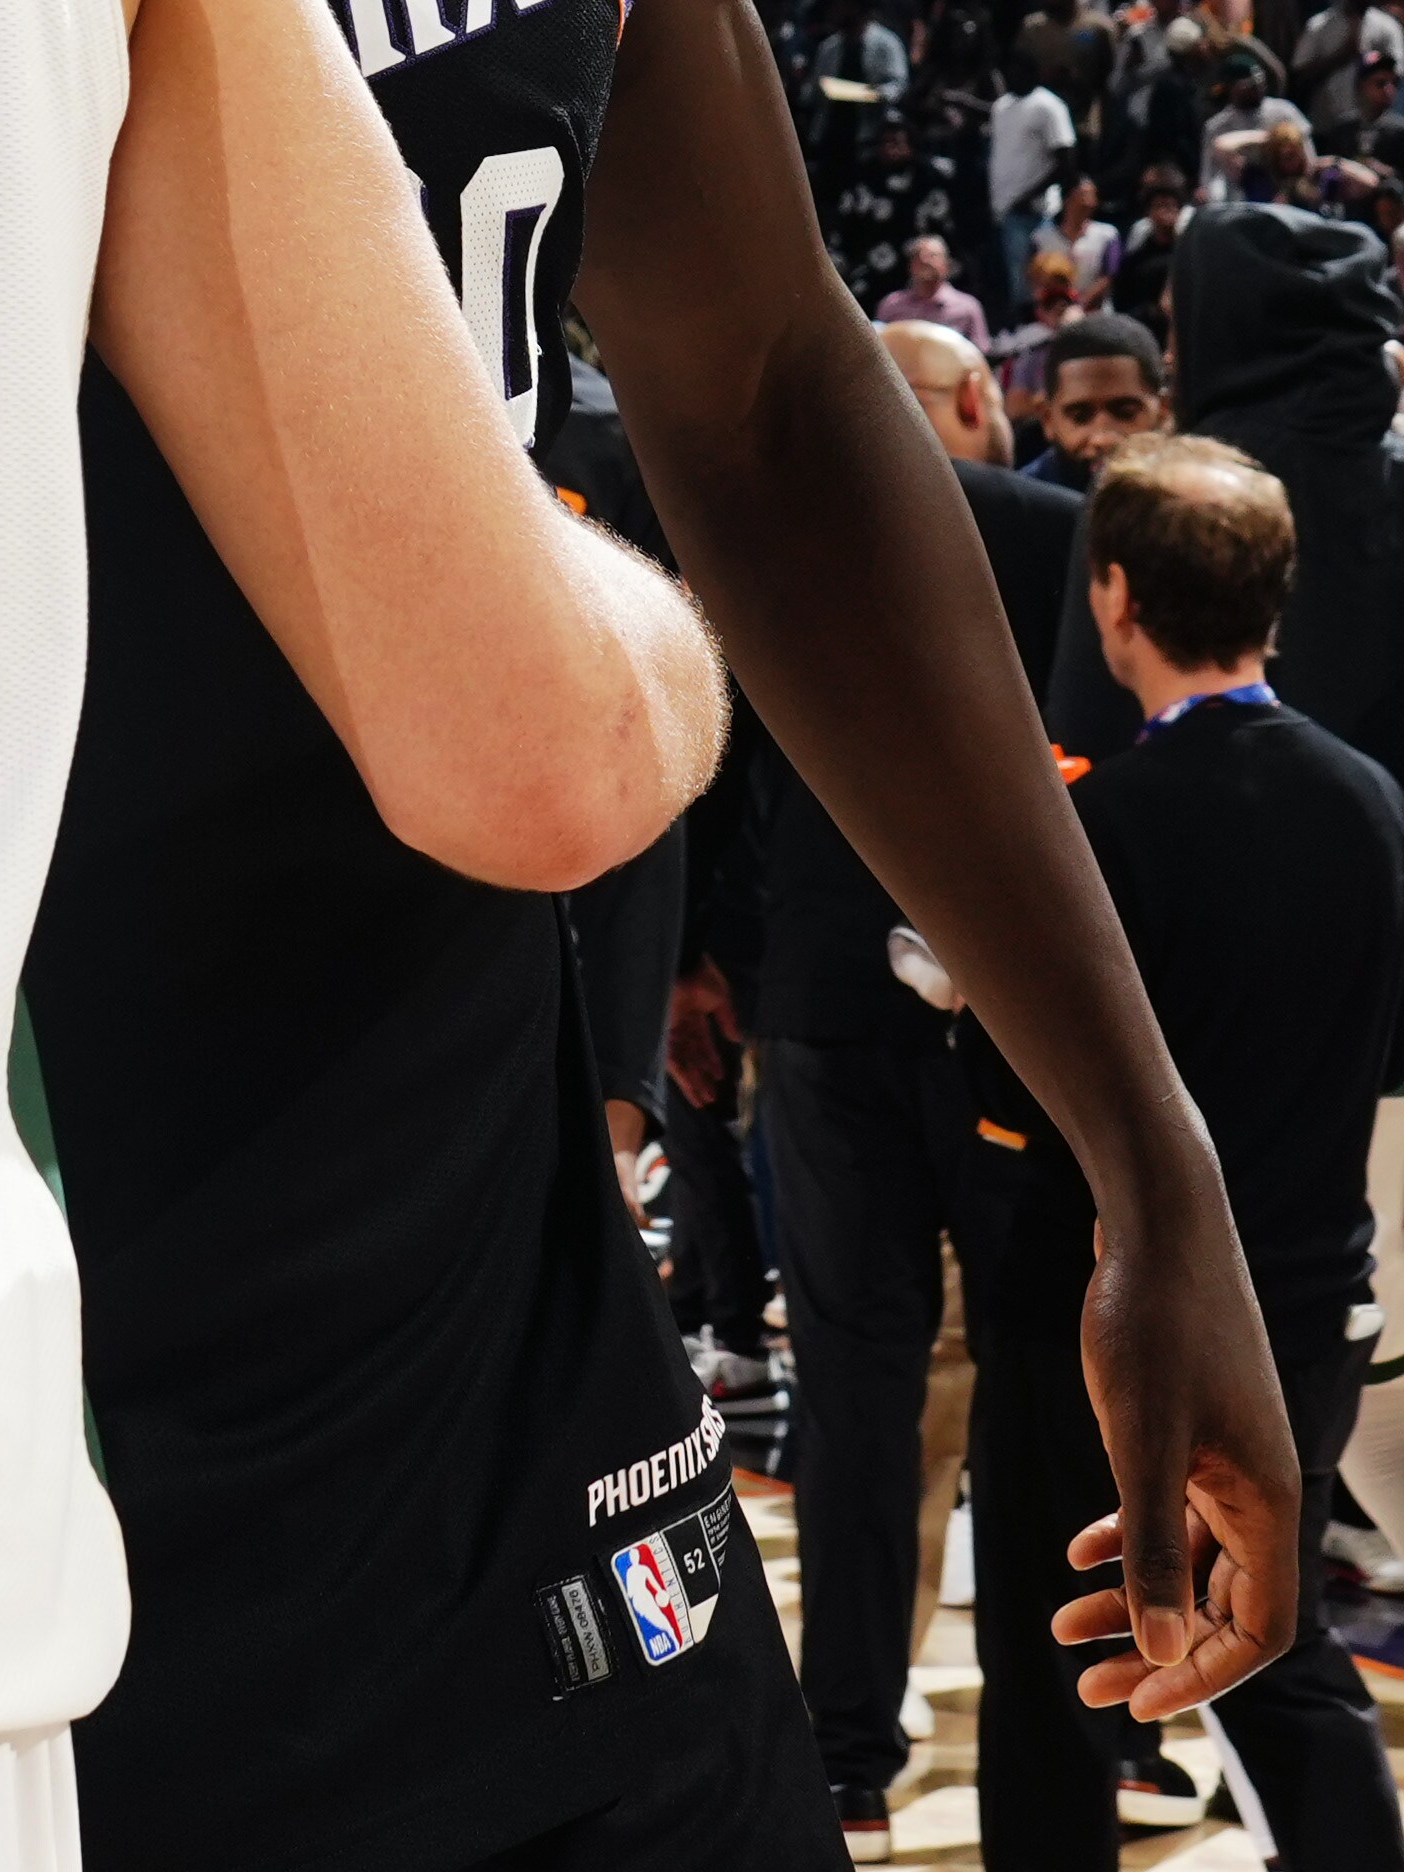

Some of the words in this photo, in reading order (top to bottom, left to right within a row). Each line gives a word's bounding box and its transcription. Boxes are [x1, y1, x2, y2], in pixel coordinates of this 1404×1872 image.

[587, 1426, 707, 1528] PHOENIX
[683, 1547, 706, 1574] 52
[648, 1633, 672, 1658] NBA
